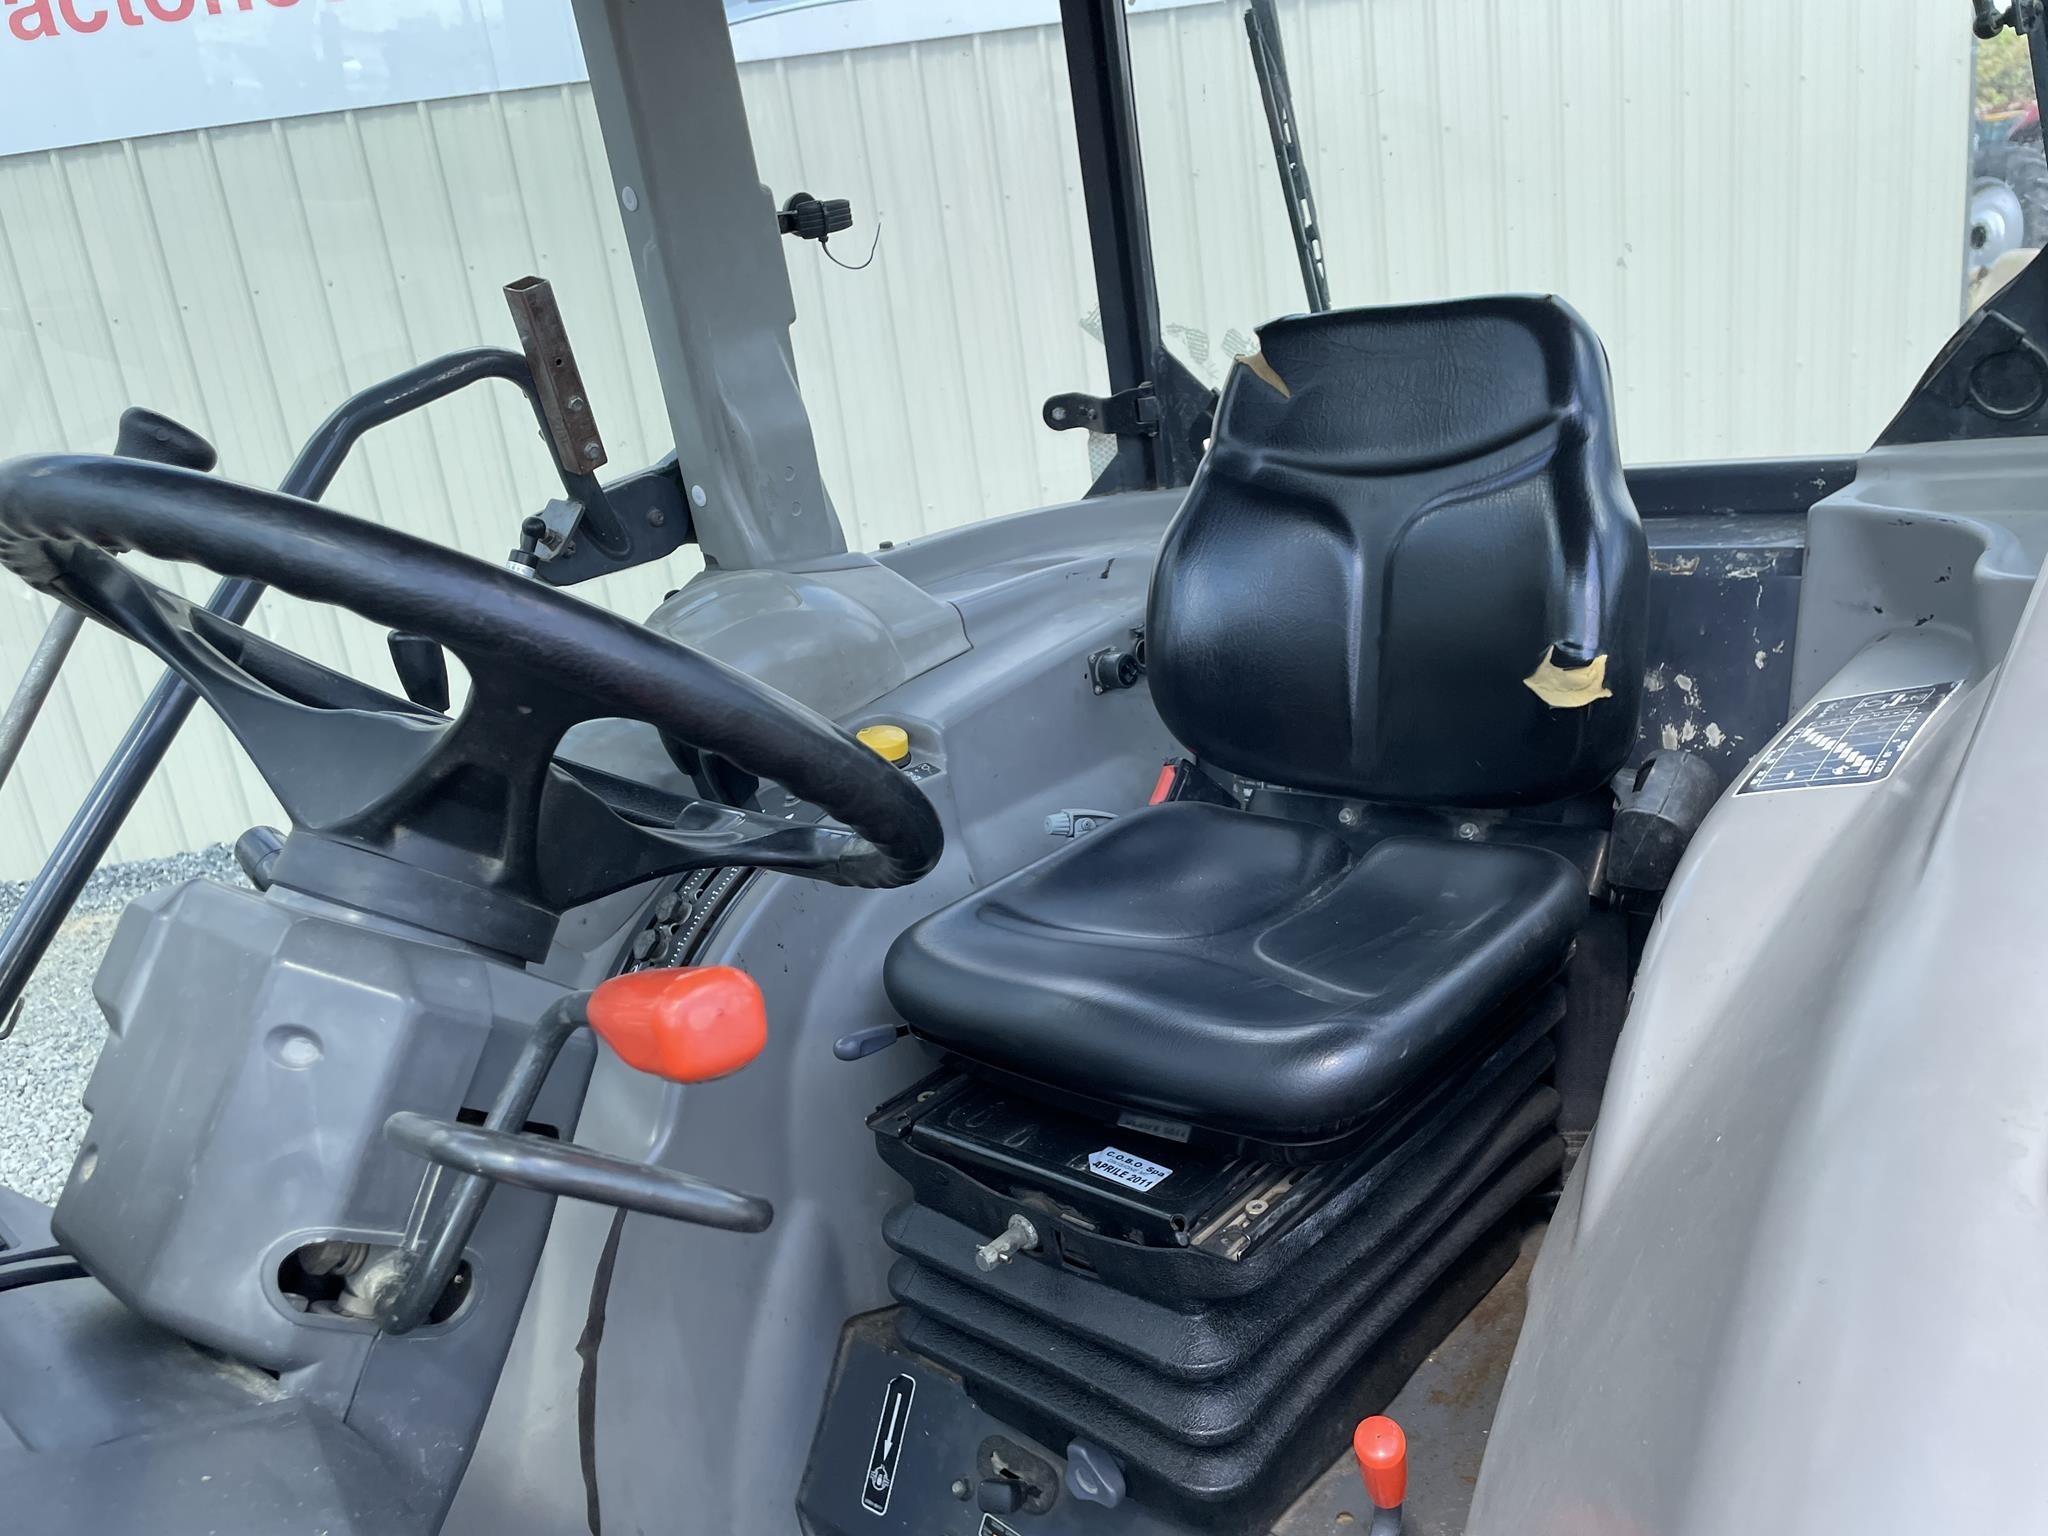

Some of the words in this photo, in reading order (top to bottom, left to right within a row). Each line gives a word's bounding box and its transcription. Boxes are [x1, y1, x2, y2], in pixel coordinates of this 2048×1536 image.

[1092, 1160, 1129, 1178] APRILE
[1126, 1174, 1153, 1188] 2011
[1106, 1151, 1144, 1169] C.O.B.O.
[1146, 1166, 1165, 1178] Spa
